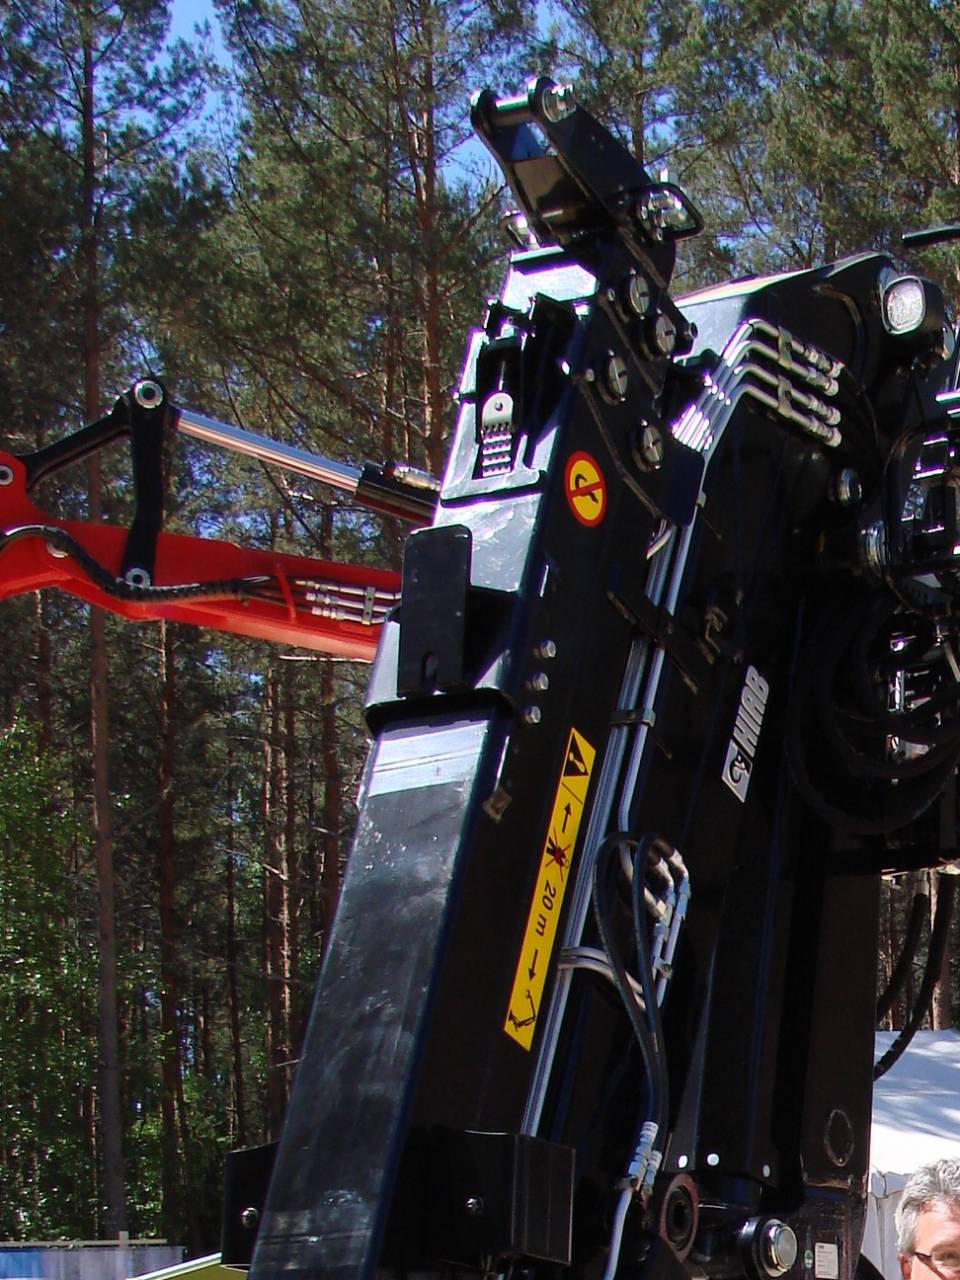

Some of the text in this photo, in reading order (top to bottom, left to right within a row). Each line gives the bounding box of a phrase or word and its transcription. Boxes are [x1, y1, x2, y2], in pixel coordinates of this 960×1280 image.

[733, 664, 770, 758] HIAB
[535, 879, 557, 937] 20 m
